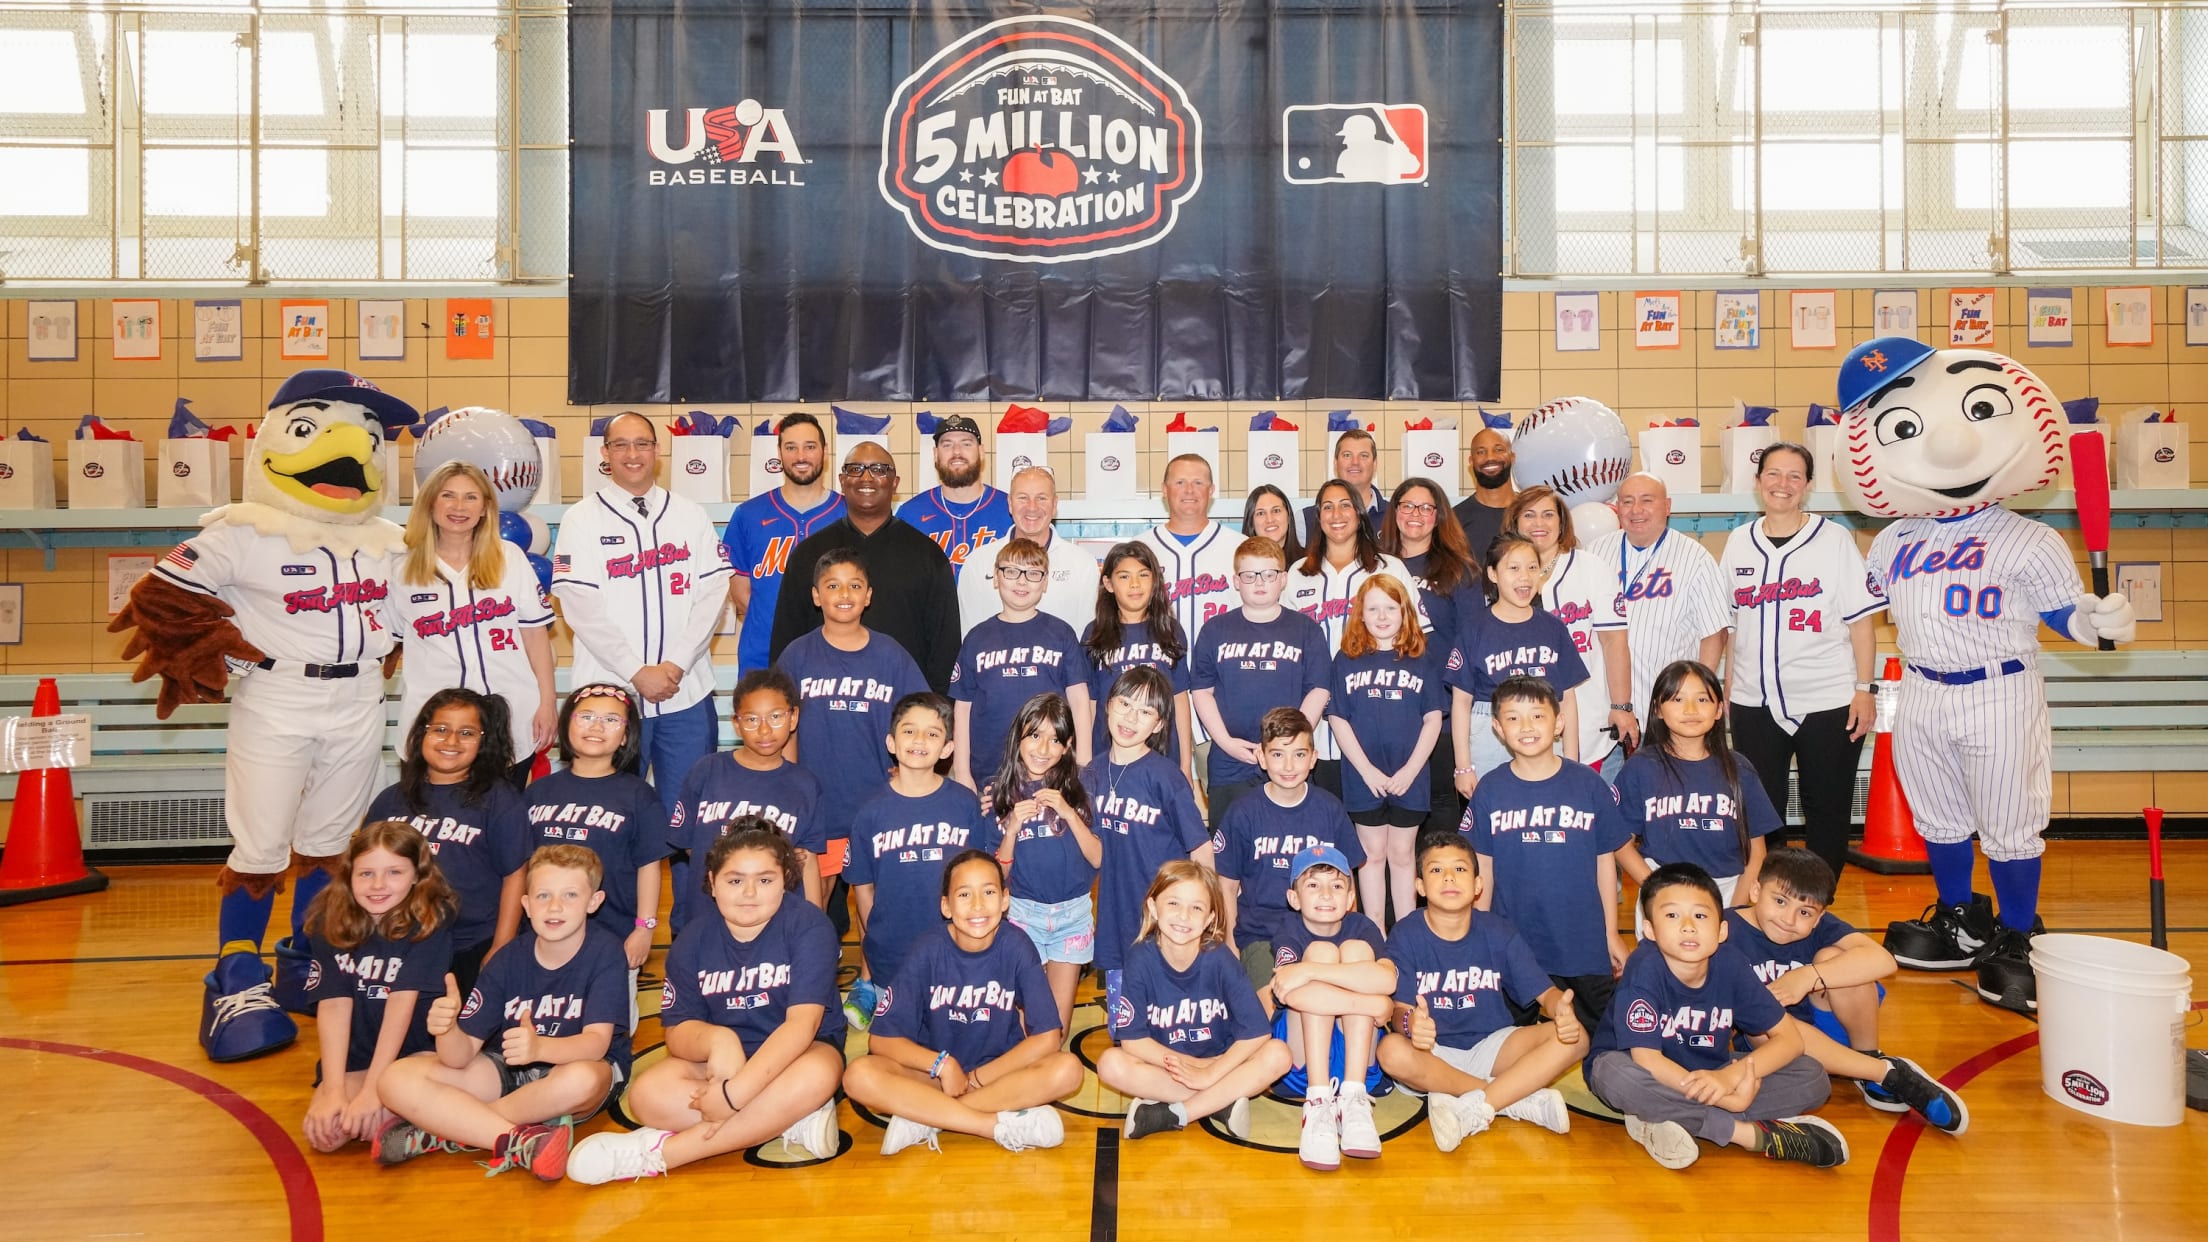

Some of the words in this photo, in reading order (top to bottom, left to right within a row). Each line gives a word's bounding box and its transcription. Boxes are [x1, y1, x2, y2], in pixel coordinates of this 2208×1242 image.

[998, 88, 1029, 105] FUN
[1033, 90, 1048, 103] AT
[1051, 87, 1082, 105] BAT
[646, 99, 805, 164] USA
[912, 110, 957, 183] 5
[963, 110, 1168, 174] MILLION
[650, 169, 805, 186] BASEBALL
[936, 182, 1144, 229] CELEBRATION
[295, 315, 316, 326] FUN
[1647, 310, 1667, 320] FUN
[1954, 320, 1968, 330] AT
[1969, 319, 1988, 330] BAT
[1961, 308, 1981, 319] FUN
[2048, 316, 2067, 327] BAT
[288, 327, 301, 338] AT
[1640, 321, 1654, 332] AT
[1655, 321, 1674, 331] BAT
[1885, 537, 1987, 585] Mets
[283, 586, 331, 614] Fun
[1779, 577, 1822, 600] Bat
[1944, 583, 2002, 620] 00
[1789, 608, 1822, 632] 24
[976, 651, 1003, 672] FUN
[1009, 647, 1030, 663] AT
[1032, 646, 1063, 667] BAT
[1127, 643, 1149, 660] AT
[1217, 642, 1247, 663] FUN
[1249, 641, 1271, 657] AT
[1273, 641, 1302, 663] BAT
[1485, 654, 1513, 675] FUN
[1515, 646, 1537, 665] AT
[800, 677, 835, 700] FUN
[838, 677, 863, 696] AT
[1344, 671, 1371, 694] FUN
[1373, 669, 1396, 686] AT
[1398, 670, 1423, 692] BAT
[555, 803, 588, 823] AT
[584, 805, 625, 832] BAT
[697, 801, 731, 825] FUN
[1124, 798, 1161, 825] BAT
[1490, 810, 1527, 834] FUN
[1529, 805, 1556, 827] AT
[1558, 805, 1595, 831] BAT
[1645, 796, 1682, 821] FUN
[1685, 793, 1712, 813] AT
[437, 817, 482, 845] BAT
[907, 823, 934, 846] AT
[937, 822, 969, 847] BAT
[1280, 835, 1304, 854] AT
[698, 969, 735, 996] FUN
[758, 963, 791, 989] BAT
[1442, 969, 1468, 992] AT
[1468, 966, 1501, 992] BAT
[535, 994, 565, 1019] AT
[957, 985, 986, 1008] AT
[1175, 998, 1197, 1024] AT
[1200, 998, 1228, 1024] BAT
[1675, 1006, 1706, 1031] AT
[1708, 1006, 1733, 1032] BA
[2065, 1077, 2071, 1087] 5
[2072, 1080, 2105, 1098] MILLION
